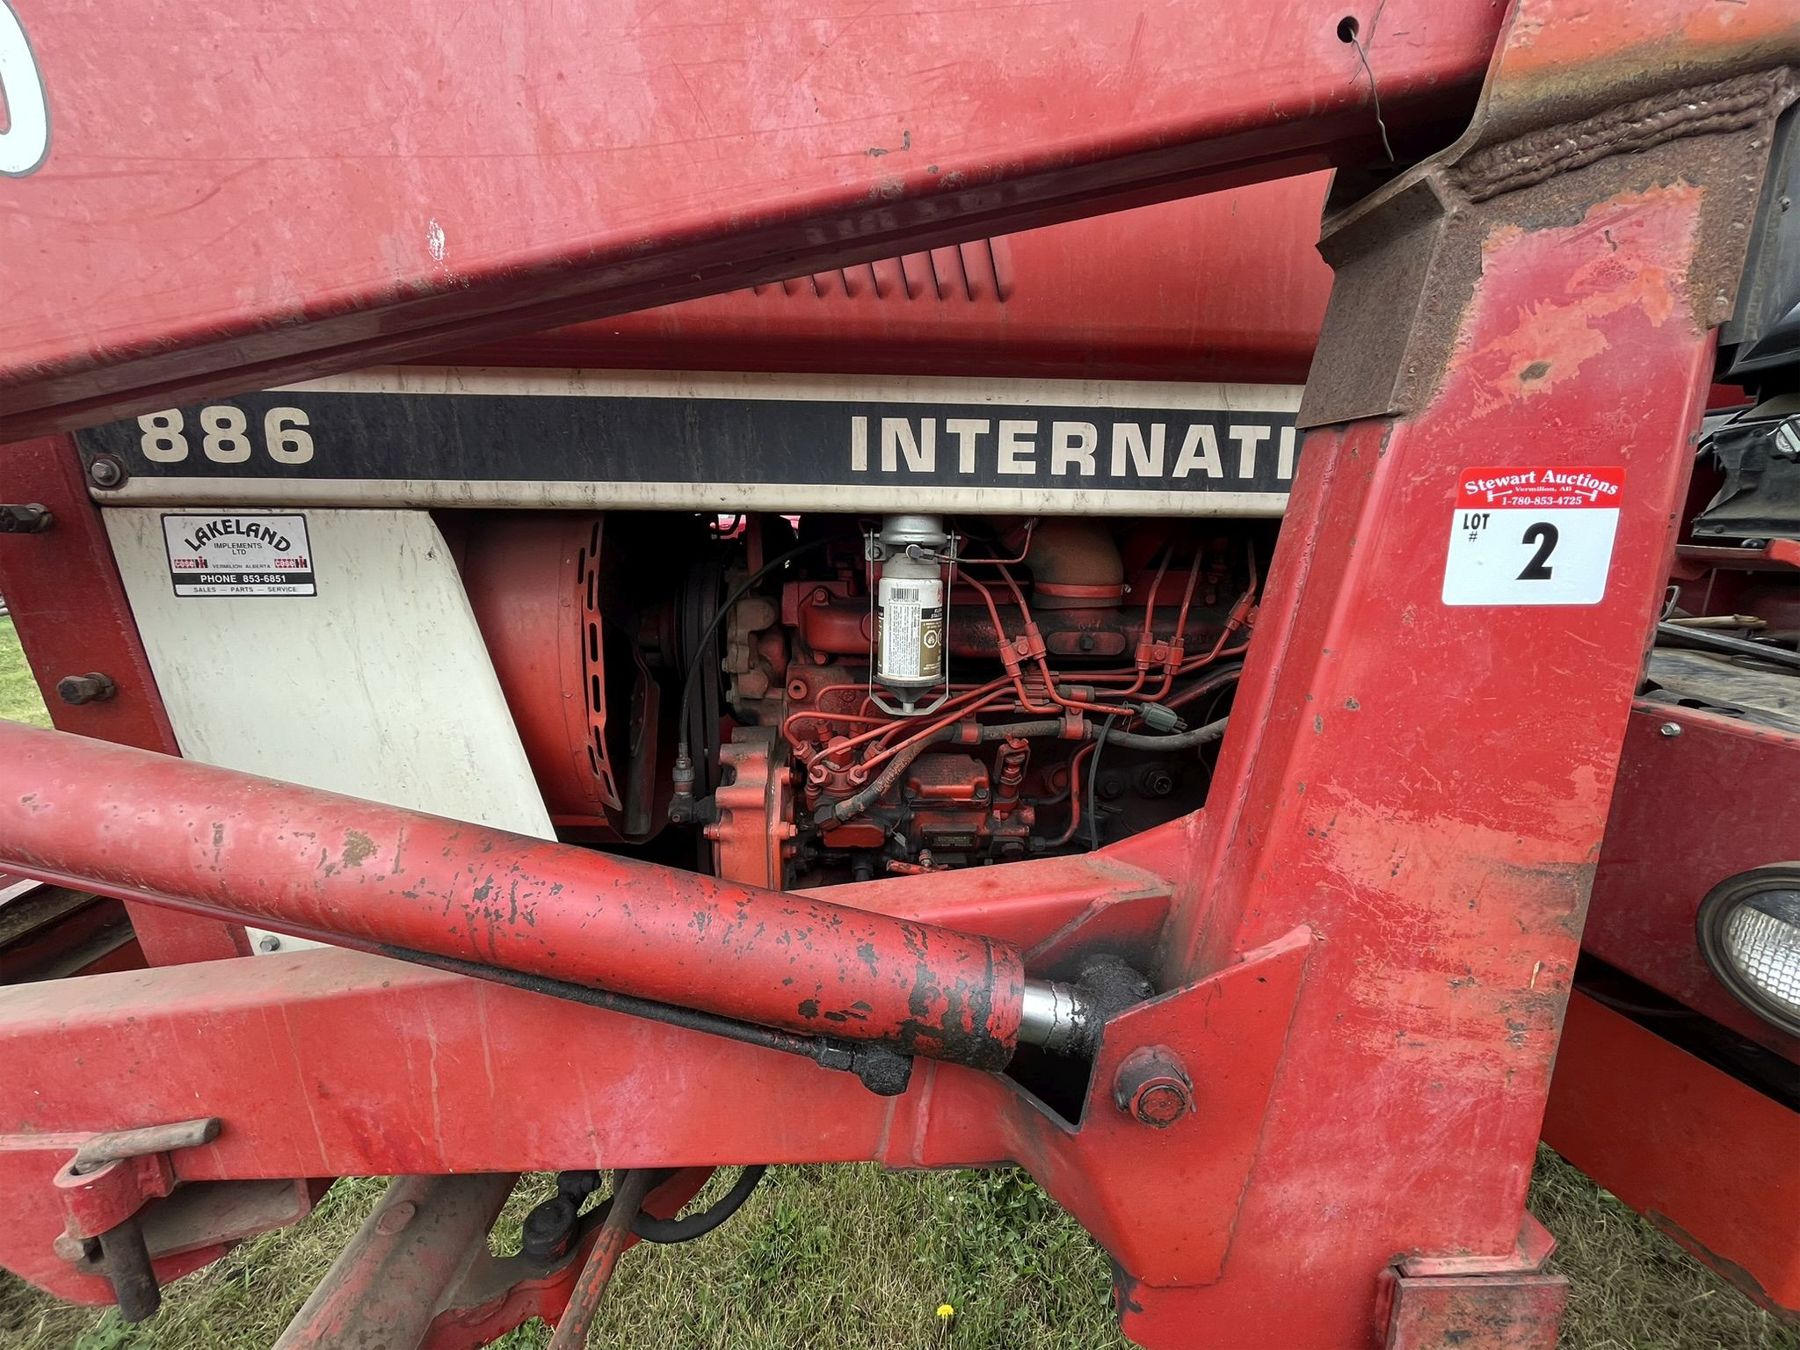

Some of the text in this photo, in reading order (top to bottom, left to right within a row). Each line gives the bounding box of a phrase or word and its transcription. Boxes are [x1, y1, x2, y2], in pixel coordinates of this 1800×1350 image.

[137, 405, 1295, 479] 886 INTERNATI
[1465, 470, 1618, 495] Stewart Auctions
[1502, 496, 1582, 505] 1-780-853-4725
[1463, 513, 1490, 529] LOT
[185, 519, 291, 551] LAKELAND
[1515, 521, 1559, 580] 2
[200, 574, 286, 583] PHONE 853-6851
